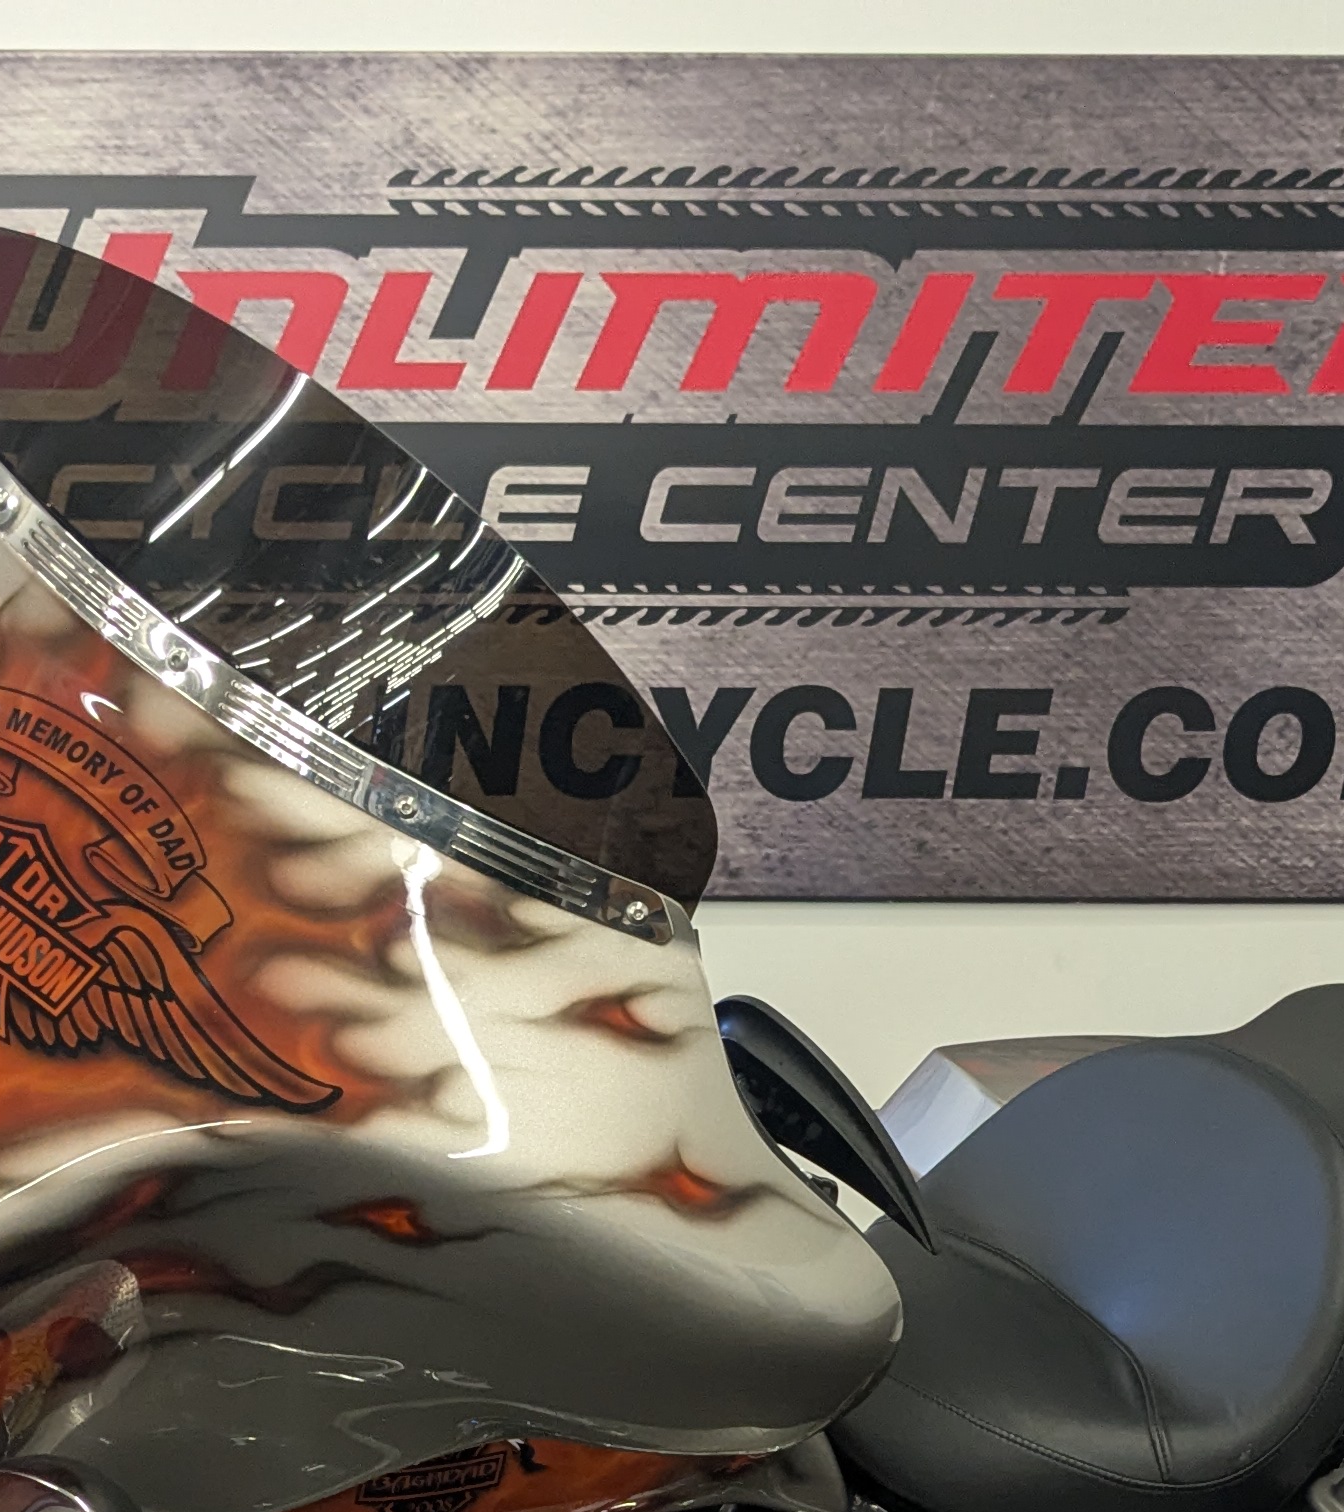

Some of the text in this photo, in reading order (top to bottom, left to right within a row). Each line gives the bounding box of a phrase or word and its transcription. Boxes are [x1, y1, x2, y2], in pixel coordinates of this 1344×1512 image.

[48, 463, 1334, 546] CYCLE CENTER
[6, 707, 125, 786] MEMORY
[118, 781, 160, 816] OF
[146, 817, 197, 872] DAD
